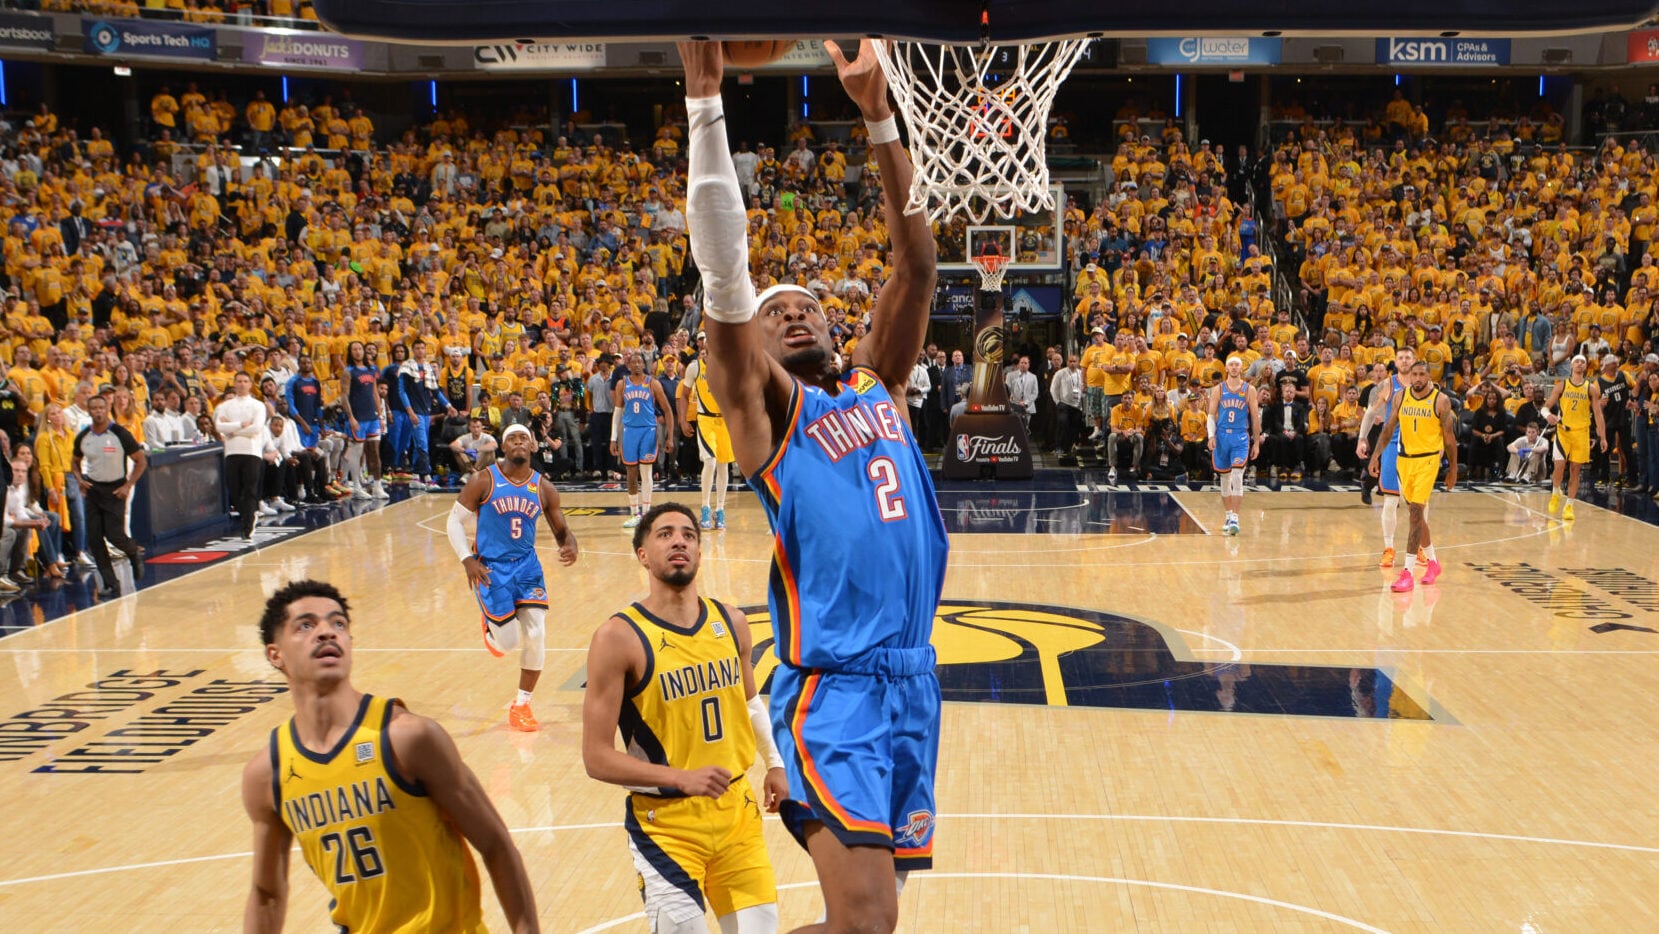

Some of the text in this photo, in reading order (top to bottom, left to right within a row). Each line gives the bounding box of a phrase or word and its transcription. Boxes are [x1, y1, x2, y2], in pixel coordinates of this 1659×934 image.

[123, 32, 210, 48] Sports Tech HQ
[526, 43, 603, 53] CITY WIDE
[1203, 39, 1247, 53] water
[1457, 42, 1488, 51] CPAs &
[293, 42, 349, 58] DONUTS
[1389, 37, 1446, 60] ksm
[1457, 52, 1496, 61] Advisors
[624, 390, 650, 401] THUNDER
[633, 402, 640, 414] 8
[1402, 406, 1432, 418] INDIANA
[1571, 400, 1579, 411] 2
[1228, 411, 1235, 423] 9
[965, 435, 1021, 462] Finals
[867, 455, 908, 523] 2
[491, 495, 540, 520] THUNDER
[510, 517, 523, 540] 5
[659, 655, 740, 701] INDIANA
[29, 679, 290, 774] FIELDHOUSE
[701, 696, 725, 743] 0
[284, 775, 397, 834] INDIANA
[320, 825, 385, 886] 26
